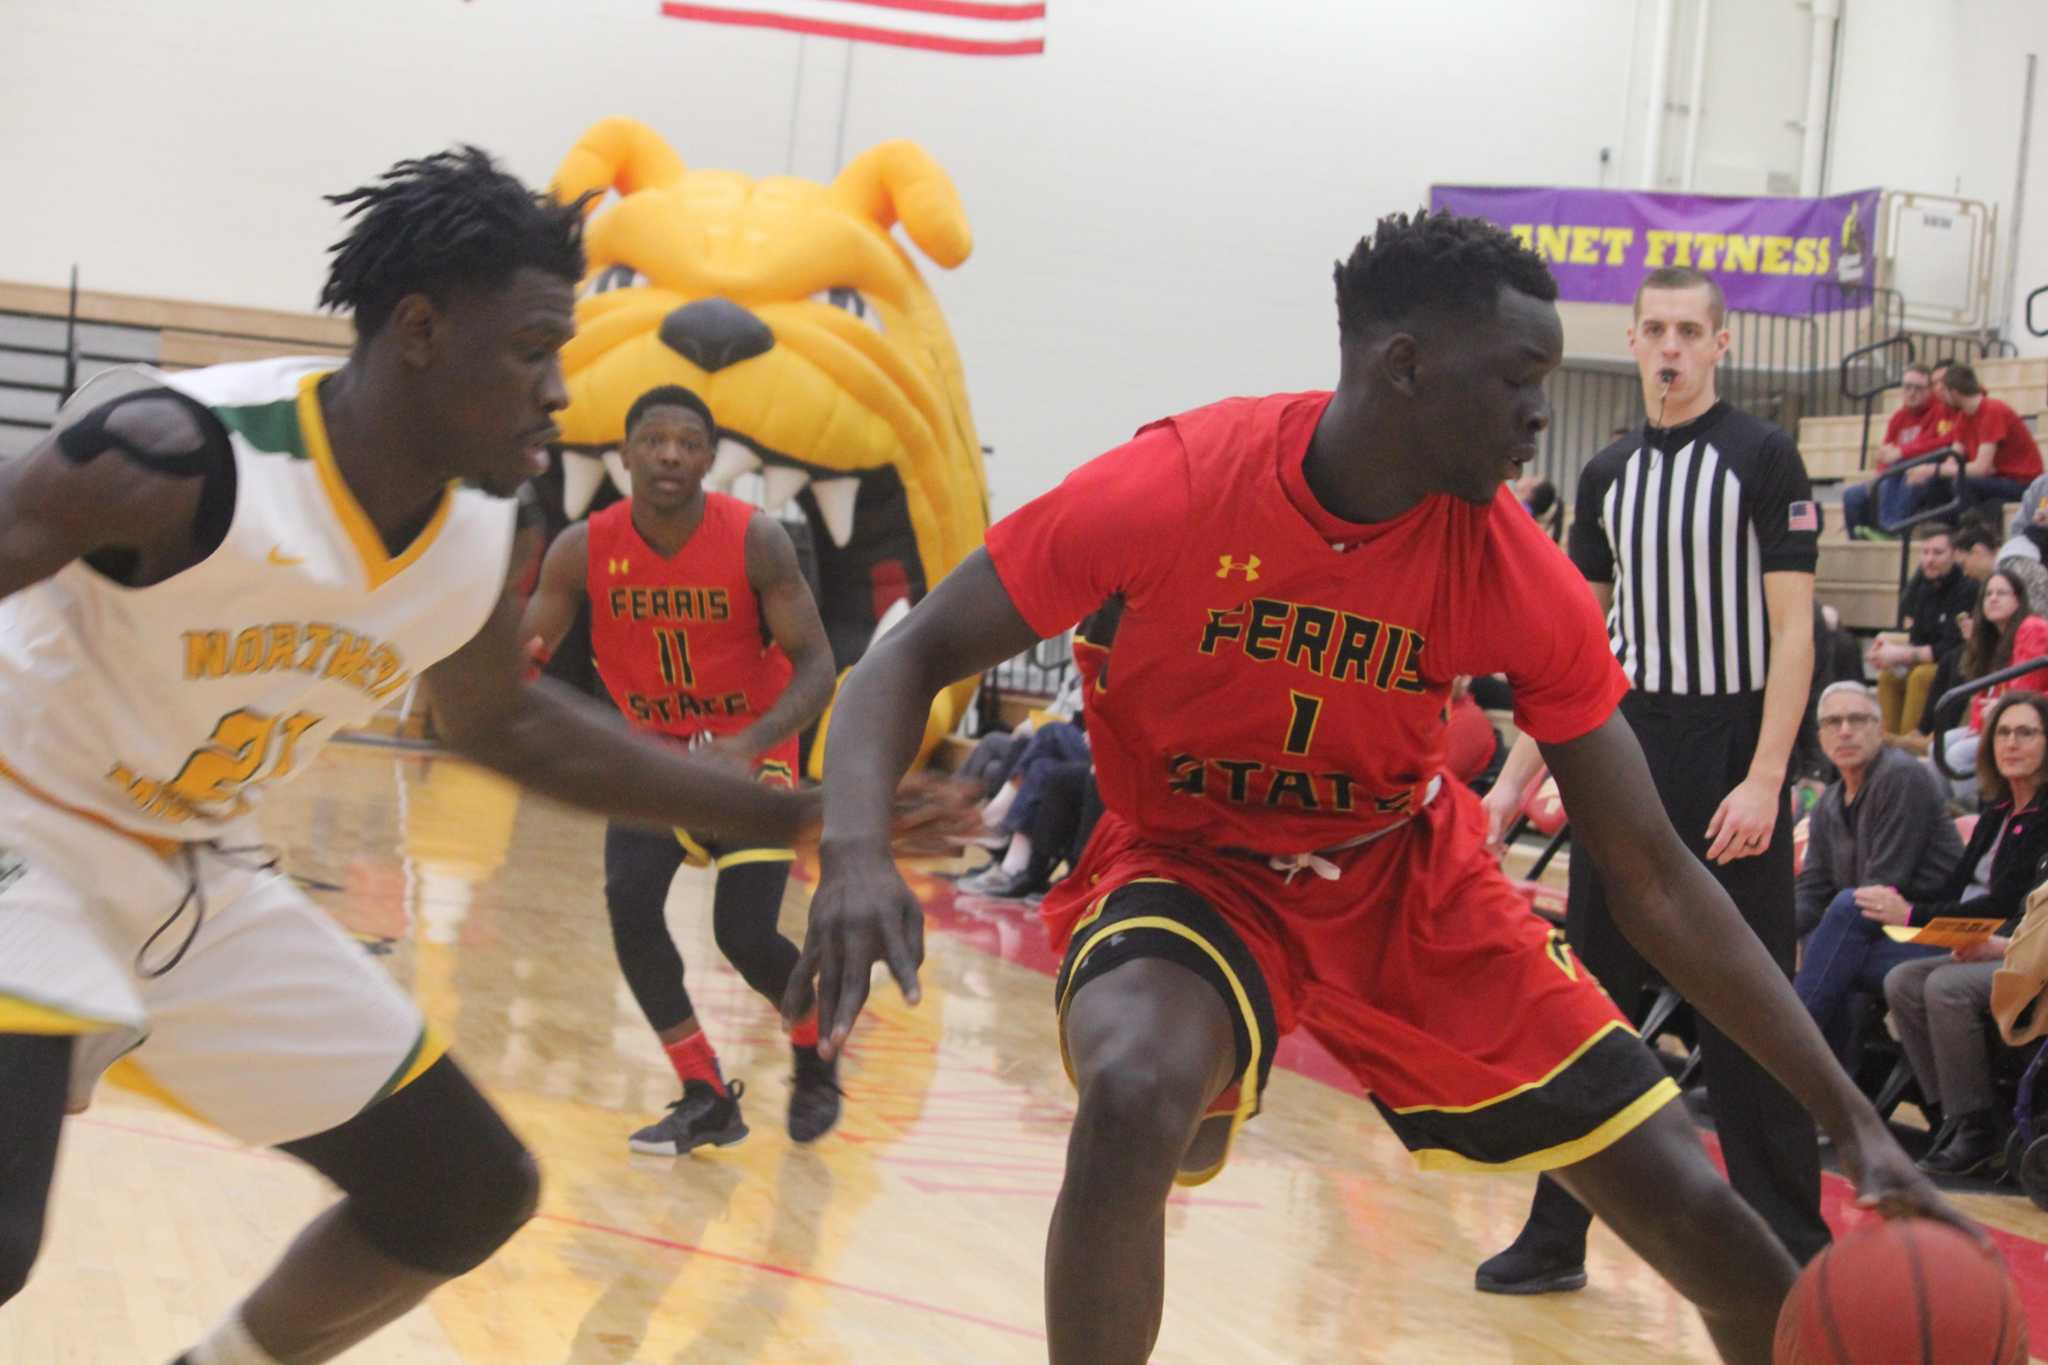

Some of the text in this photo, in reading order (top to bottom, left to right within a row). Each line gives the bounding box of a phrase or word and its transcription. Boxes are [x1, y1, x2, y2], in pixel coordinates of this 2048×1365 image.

[1644, 229, 1831, 276] FITNESS
[609, 586, 730, 623] FERRIS
[653, 627, 696, 689] 11
[1282, 689, 1323, 756] 1
